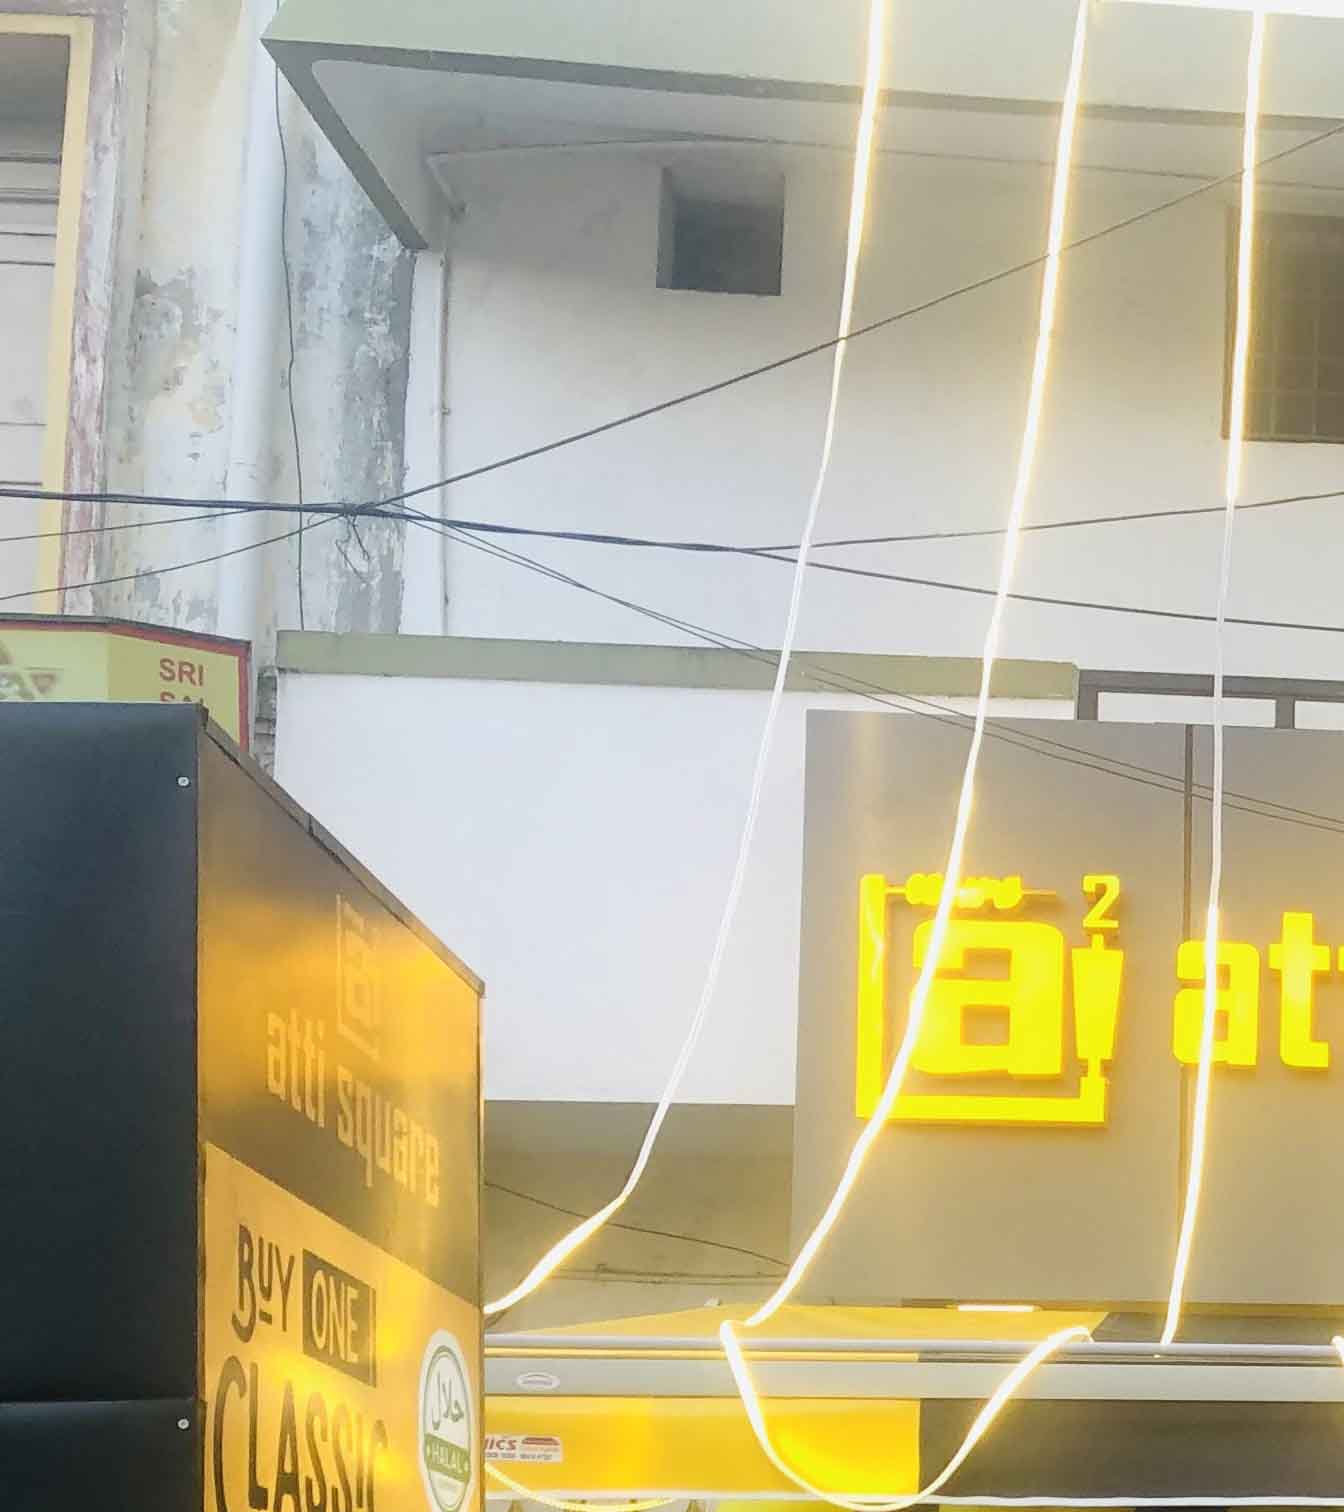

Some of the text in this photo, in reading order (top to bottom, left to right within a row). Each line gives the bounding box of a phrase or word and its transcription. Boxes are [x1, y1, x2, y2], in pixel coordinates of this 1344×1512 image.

[159, 657, 205, 687] SRI
[266, 1007, 440, 1208] atti square
[231, 1223, 360, 1364] BUY ONE
